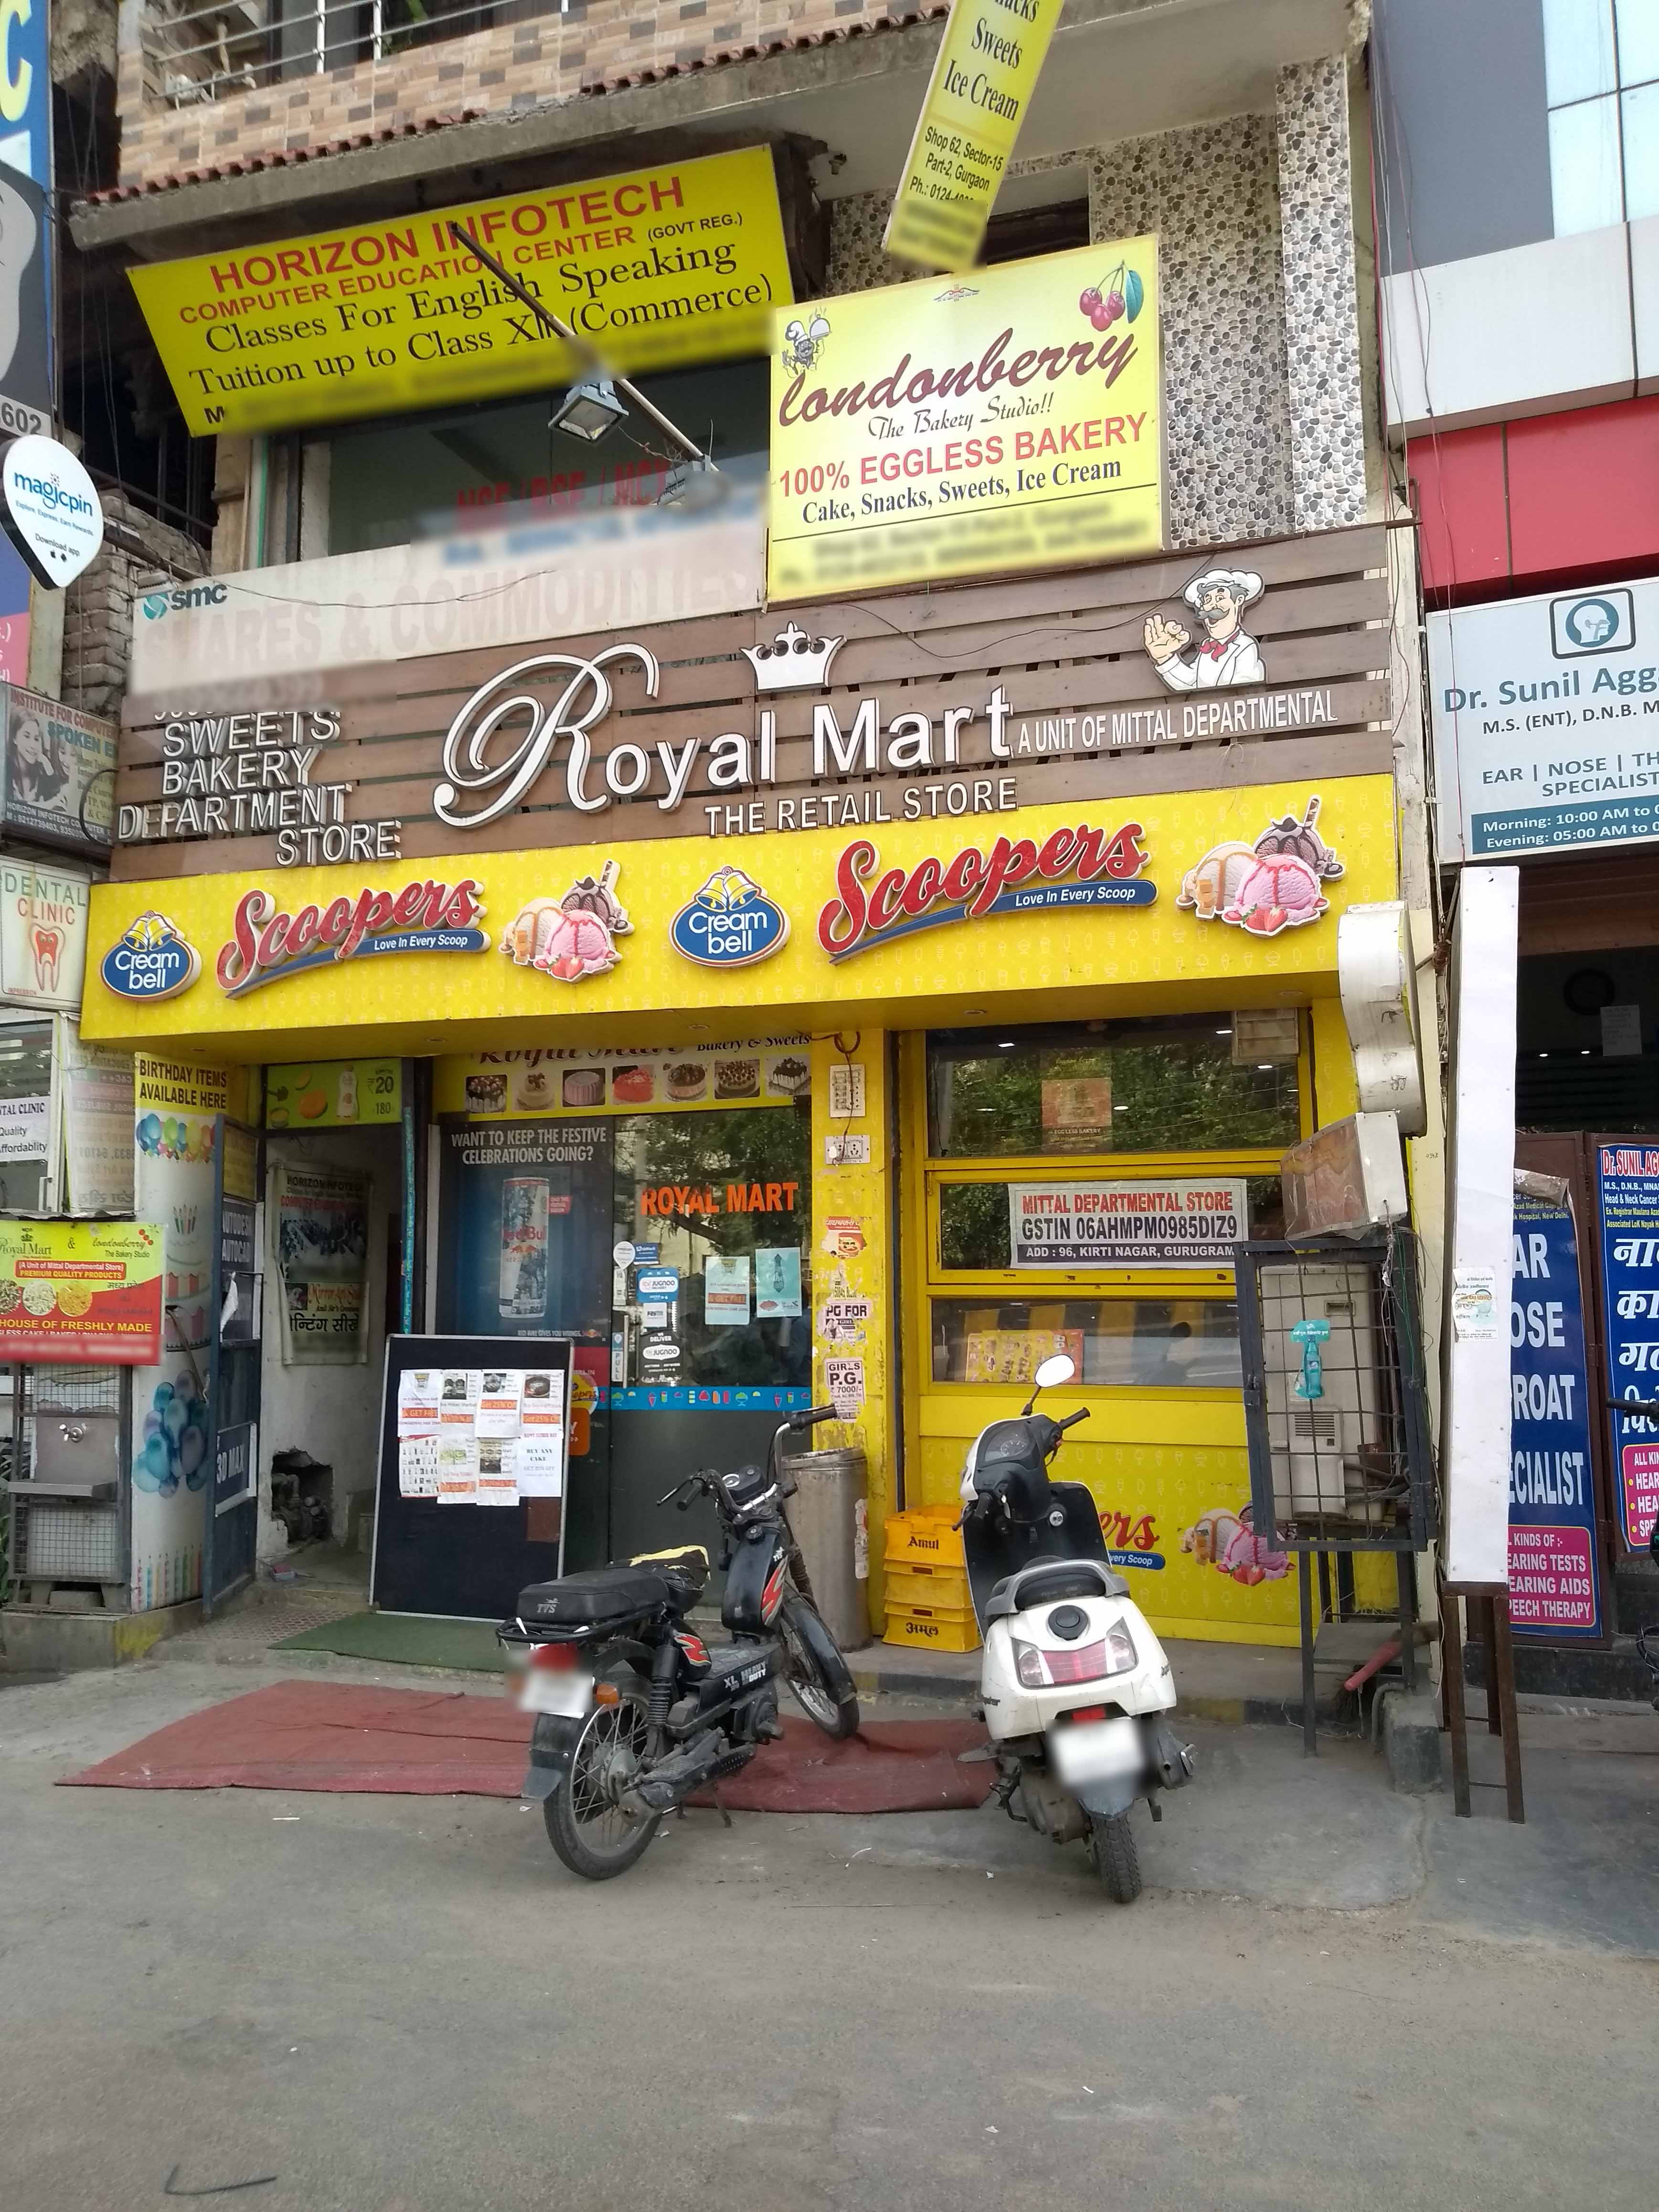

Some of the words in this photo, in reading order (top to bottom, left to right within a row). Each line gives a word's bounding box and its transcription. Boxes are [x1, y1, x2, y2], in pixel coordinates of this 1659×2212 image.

[971, 17, 1022, 69] Sweets
[943, 59, 968, 97] Ice
[970, 73, 1019, 121] Cream
[925, 126, 948, 152] Shop
[949, 136, 961, 158] 62,
[964, 142, 1004, 172] Sector-15
[925, 152, 952, 180] Part-2,
[955, 164, 990, 191] Gurgaon
[209, 228, 420, 293] HORIZON
[431, 176, 685, 253] INFOTECH
[179, 282, 332, 324] COMPUTER
[512, 225, 636, 265] CENTER
[647, 221, 695, 243] (GOVT
[700, 212, 743, 232] REG.)
[205, 315, 328, 352] Classes
[334, 303, 396, 333] For
[405, 266, 544, 319] English
[559, 243, 737, 299] Speaking
[188, 362, 306, 395] Tuition
[313, 353, 355, 378] up
[364, 346, 397, 368] to
[407, 323, 493, 361] Class
[570, 273, 773, 336] (Commerce)
[778, 327, 1138, 427] londonberry
[1, 402, 42, 435] 602
[868, 415, 904, 441] The
[913, 408, 974, 436] Bakery
[979, 391, 1054, 424] Studio!!
[779, 460, 850, 498] 100%
[860, 435, 1004, 486] EGGLESS
[1015, 411, 1147, 461] BAKERY
[13, 472, 93, 517] magicpin
[802, 497, 856, 524] Cake,
[861, 486, 933, 516] Snacks,
[938, 475, 1010, 504] Sweets,
[1016, 467, 1046, 492] Ice
[1052, 460, 1122, 486] Cream
[35, 533, 67, 553] Download
[66, 546, 80, 557] app
[170, 584, 228, 611] smc
[1444, 688, 1488, 713] Dr.
[1499, 669, 1581, 705] Sunil
[1017, 722, 1032, 754] A
[1034, 717, 1077, 753] UNIT
[1081, 716, 1106, 747] OF
[1111, 708, 1178, 745] MITTAL
[1183, 690, 1338, 738] DEPARTMENTAL
[1482, 718, 1521, 734] M.S.
[1525, 710, 1577, 733] (ENT),
[1582, 703, 1638, 722] D.N.B.
[162, 711, 341, 758] SWEETS
[433, 642, 777, 829] Royal
[812, 684, 1015, 777] Mart
[161, 745, 321, 796] BAKERY
[1482, 767, 1523, 785] EAR
[1548, 757, 1607, 777] NOSE
[1541, 771, 1659, 798] SPECIALIST
[118, 783, 352, 841] DEPARTMENT
[704, 800, 766, 838] THE
[776, 790, 892, 832] RETAIL
[902, 776, 1019, 821] STORE
[1482, 816, 1553, 833] Morning:
[1555, 811, 1598, 825] 10:00
[1602, 807, 1629, 820] AM
[1633, 807, 1650, 817] to
[276, 819, 402, 867] STORE
[1486, 833, 1550, 849] Evening:
[1552, 829, 1596, 841] 05:00
[1599, 825, 1627, 837] AM
[1631, 824, 1648, 834] to
[5, 872, 86, 906] DENTAL
[817, 822, 1151, 956] Scoopers
[1015, 892, 1044, 907] Love
[1046, 892, 1057, 902] In
[1060, 889, 1095, 904] Every
[1097, 887, 1136, 901] Scoop
[18, 897, 75, 925] CLINIC
[688, 911, 768, 933] Cream
[216, 878, 485, 992] Scoopers
[374, 936, 397, 951] Love
[397, 936, 408, 948] In
[409, 934, 436, 951] Every
[437, 933, 468, 949] Scoop
[706, 930, 753, 954] bell
[115, 950, 180, 971] Cream
[128, 968, 166, 990] bell
[139, 1059, 193, 1082] BIRTHDAY
[196, 1069, 227, 1088] ITEMS
[19, 1102, 45, 1115] CLINIC
[139, 1082, 197, 1106] AVAILABLE
[200, 1091, 227, 1109] HERE
[0, 1126, 27, 1137] Quality
[451, 1131, 486, 1147] WANT
[489, 1131, 504, 1146] TO
[507, 1130, 535, 1145] KEEP
[537, 1128, 559, 1144] THE
[562, 1127, 607, 1143] FESTIVE
[462, 1147, 543, 1165] CELEBRATIONS
[547, 1146, 594, 1162] GOING?
[1603, 1149, 1616, 1176] Dr.
[1616, 1149, 1645, 1177] SUNIL
[641, 1185, 720, 1216] ROYAL
[727, 1182, 799, 1213] MART
[1604, 1181, 1620, 1191] M.S.,
[1620, 1182, 1643, 1192] D.N.B.,
[1605, 1193, 1618, 1204] Head
[1619, 1193, 1624, 1204] &
[1625, 1193, 1638, 1204] Neck
[1639, 1194, 1658, 1204] Cancer
[1021, 1194, 1071, 1214] MITTAL
[1074, 1191, 1183, 1213] DEPARTMENTAL
[1186, 1191, 1233, 1212] STORE
[1613, 1207, 1632, 1217] Registrar
[1021, 1216, 1071, 1241] GSTIN
[1519, 1213, 1541, 1221] Hospital,
[1606, 1219, 1631, 1228] Associated
[1640, 1220, 1655, 1230] Nayak
[28, 1243, 52, 1255] Mart
[67, 1237, 75, 1249] &
[1026, 1246, 1050, 1257] ADD
[1059, 1246, 1077, 1259] 96,
[1079, 1245, 1112, 1257] KIRTI
[1115, 1245, 1161, 1258] NAGAR,
[1164, 1244, 1234, 1257] GURUGRAM
[845, 1305, 867, 1317] FOR
[0, 1319, 39, 1329] HOUSE
[42, 1320, 58, 1329] OF
[61, 1320, 114, 1332] FRESHLY
[117, 1323, 153, 1332] MADE
[829, 1372, 862, 1385] P.G.
[228, 1444, 245, 1478] MAX
[1634, 1452, 1648, 1466] ALL
[907, 1536, 940, 1550] Amul
[1514, 1533, 1542, 1546] KINDS
[1543, 1534, 1555, 1547] OF
[1109, 1553, 1127, 1565] very
[1127, 1555, 1153, 1567] Scoop
[1550, 1554, 1587, 1573] TESTS
[1509, 1576, 1556, 1594] EARING
[1559, 1578, 1590, 1595] AIDS
[536, 1603, 557, 1614] TVS
[1542, 1600, 1591, 1619] THERAPY
[723, 1674, 739, 1689] XL
[748, 1669, 767, 1683] DUTY
